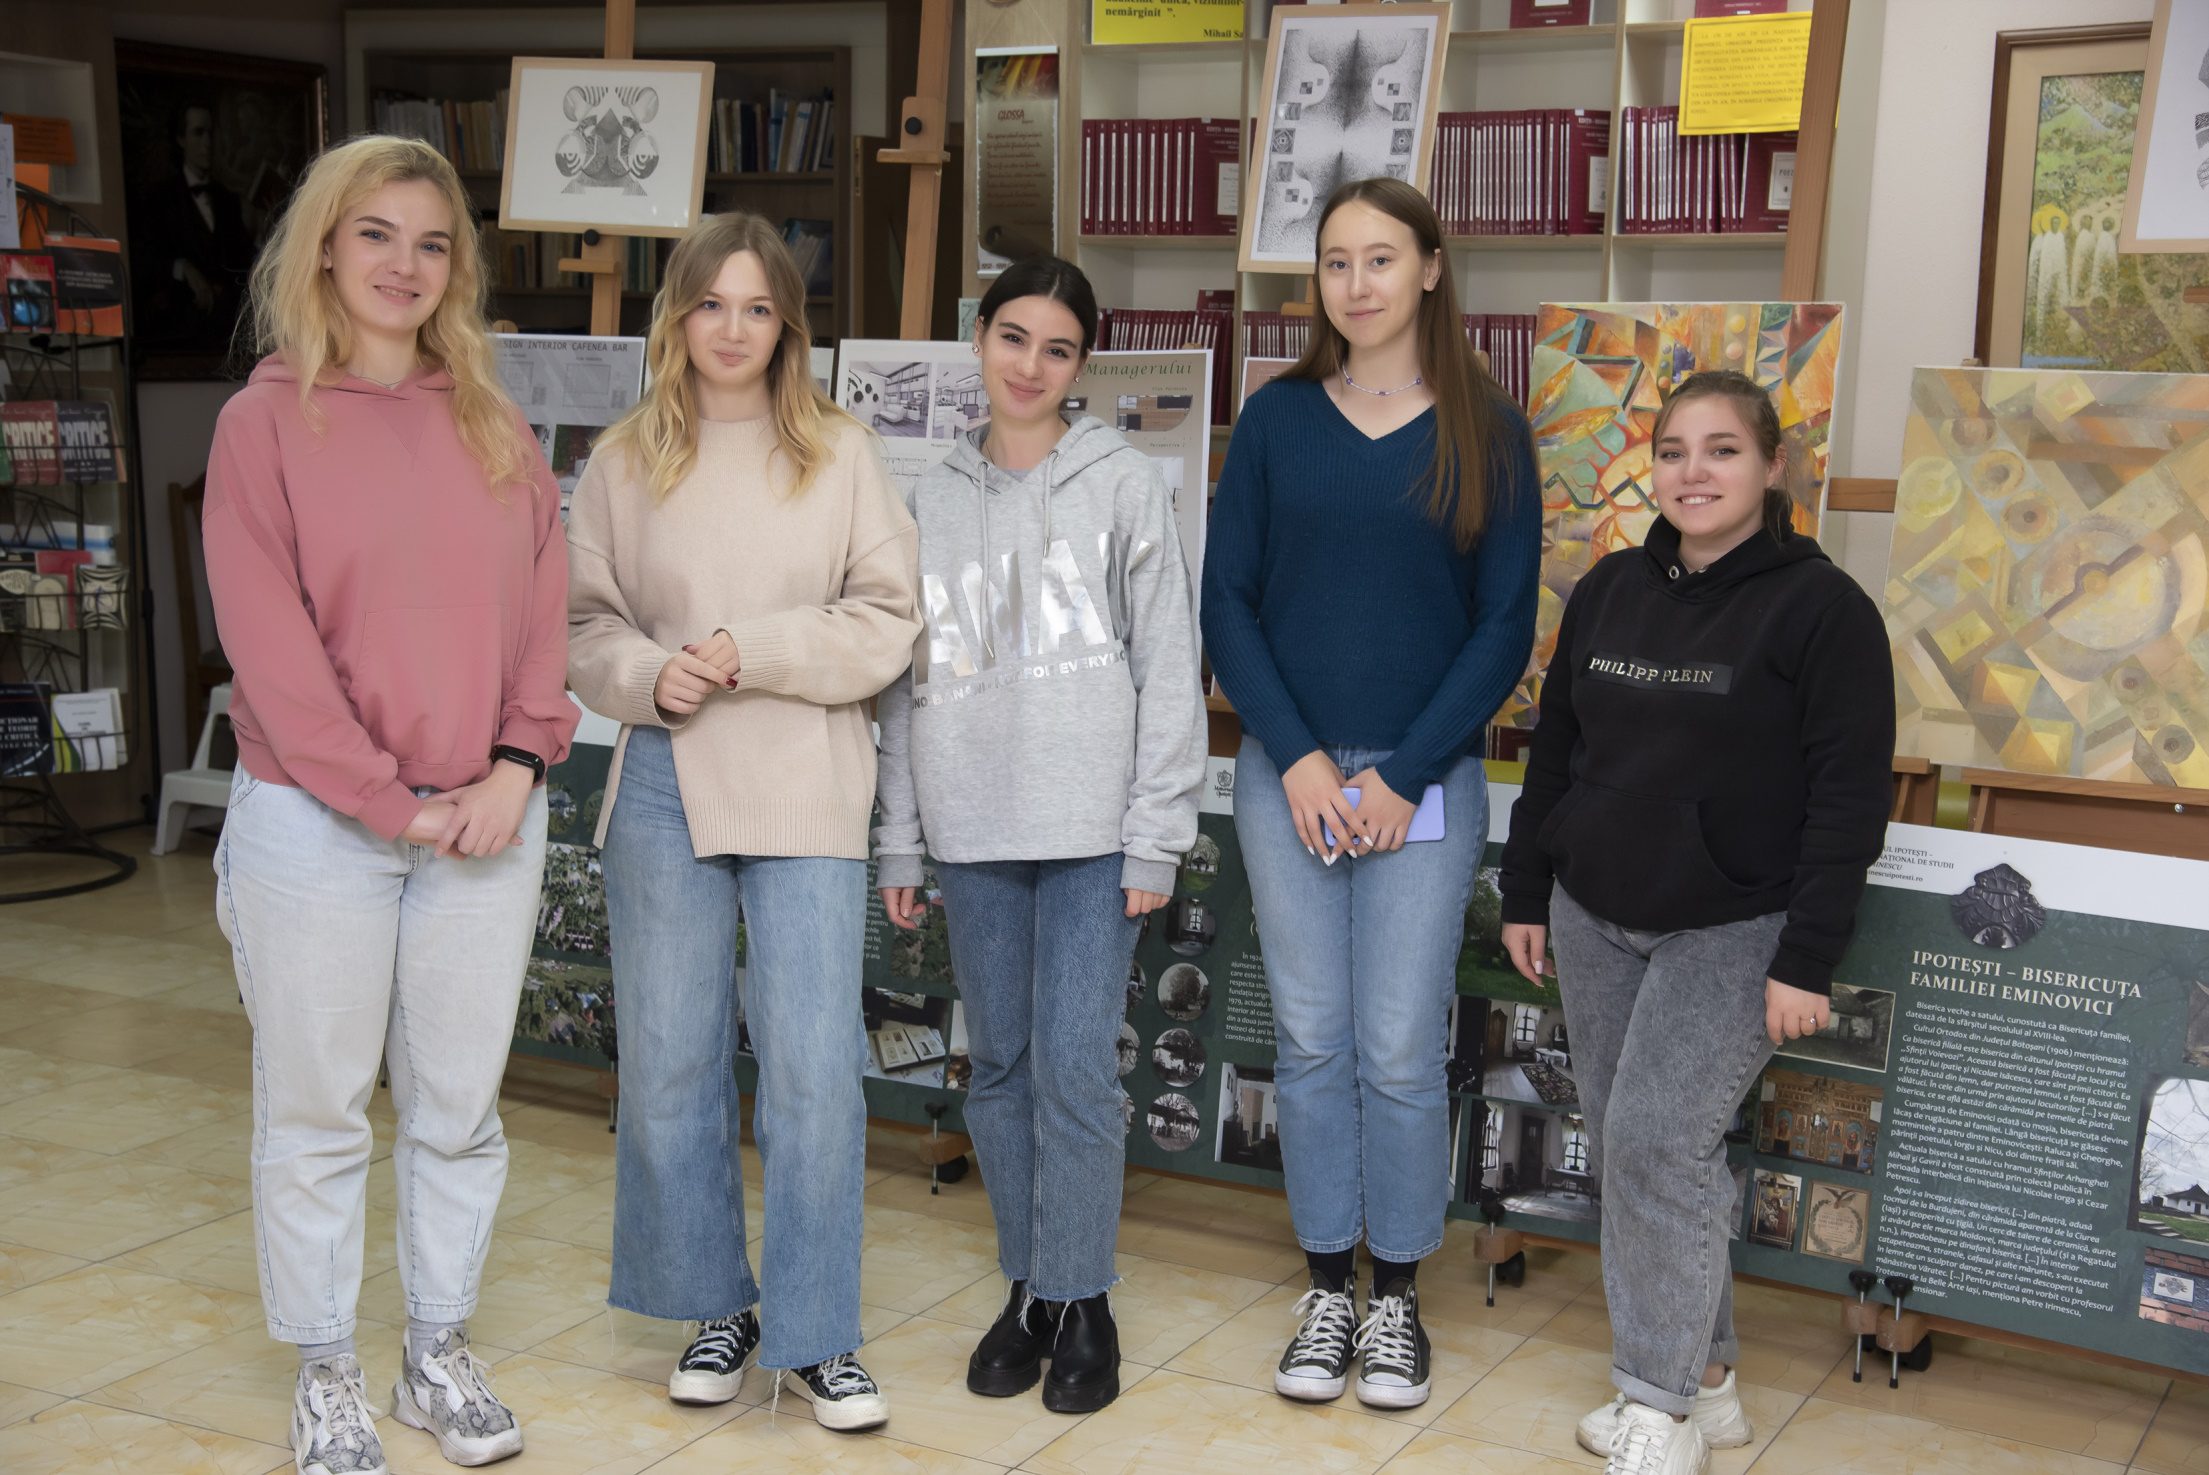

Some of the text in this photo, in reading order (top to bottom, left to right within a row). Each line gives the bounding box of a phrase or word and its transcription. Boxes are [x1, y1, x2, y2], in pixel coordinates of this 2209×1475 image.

[1105, 8, 1161, 19] nemărginit
[1203, 28, 1232, 38] Mihail
[528, 341, 567, 350] INTERIOR
[571, 342, 608, 352] CAFENEA
[612, 343, 628, 352] BAR
[1083, 359, 1193, 380] Managerului
[1589, 657, 1713, 683] PHILIPP PLEIN
[1917, 858, 1927, 866] DE
[1928, 860, 1954, 869] STUDII
[1912, 950, 2001, 977] IPOTEȘTI
[2021, 966, 2142, 999] BISERICUȚA
[1244, 1000, 1267, 1008] actualul
[1909, 971, 2114, 1016] FAMILIEI EMINOVICI
[1227, 1005, 1249, 1014] interior
[1916, 1001, 1945, 1012] Biserica
[1946, 1007, 1969, 1016] veche
[1977, 1012, 2004, 1022] satului,
[2099, 1030, 2130, 1042] familiei,
[1225, 1024, 1248, 1033] treizeci
[1225, 1034, 1255, 1043] construită
[1905, 1010, 1935, 1020] datează
[1947, 1016, 1955, 1024] la
[1988, 1024, 2022, 1034] secolului
[2032, 1030, 2066, 1042] XVIII-lea.
[1913, 1023, 1935, 1032] Cultul
[1935, 1027, 1967, 1038] Ortodox
[2046, 1045, 2072, 1057] (1906)
[1902, 1034, 1911, 1042] Ca
[1912, 1036, 1940, 1046] biserică
[1980, 1047, 2009, 1058] biserica
[2010, 1052, 2022, 1060] din
[2024, 1055, 2053, 1065] cătunul
[2096, 1066, 2125, 1077] hramul
[1904, 1065, 1918, 1074] fost
[1920, 1068, 1943, 1078] făcută
[1958, 1075, 1978, 1085] lemn,
[1994, 1083, 2032, 1093] putrezind
[2033, 1088, 2061, 1099] lemnul,
[2069, 1094, 2085, 1103] fost
[2087, 1097, 2112, 1107] făcută
[2113, 1102, 2126, 1110] din
[1895, 1085, 1925, 1097] biserica,
[1946, 1094, 1960, 1102] află
[1998, 1104, 2033, 1115] cărămidă
[2046, 1112, 2075, 1123] temelie
[2076, 1117, 2087, 1125] de
[2088, 1120, 2114, 1129] piatră.
[1958, 1109, 1995, 1121] Eminovici
[1996, 1117, 2019, 1126] odată
[2100, 1135, 2128, 1145] devine
[1891, 1119, 1935, 1131] mormintele
[1943, 1128, 1964, 1137] patru
[1966, 1131, 1989, 1141] dintre
[2044, 1145, 2070, 1156] Raluca
[2080, 1153, 2122, 1167] Gheorghe,
[1918, 1134, 1952, 1146] poetului,
[1954, 1140, 1974, 1150] Iorgu
[1984, 1145, 2003, 1156] Nicu,
[2005, 1149, 2018, 1157] doi
[2019, 1152, 2043, 1162] dintre
[1885, 1171, 1920, 1183] Petrescu.
[1886, 1162, 1920, 1173] perioada
[1921, 1168, 1961, 1181] interbelică
[1963, 1175, 1975, 1183] din
[2011, 1184, 2021, 1192] lui
[2022, 1187, 2052, 1198] Nicolae
[2054, 1193, 2075, 1204] Iorga
[2084, 1199, 2108, 1209] Cezar
[1912, 1283, 1948, 1298] ensionar.
